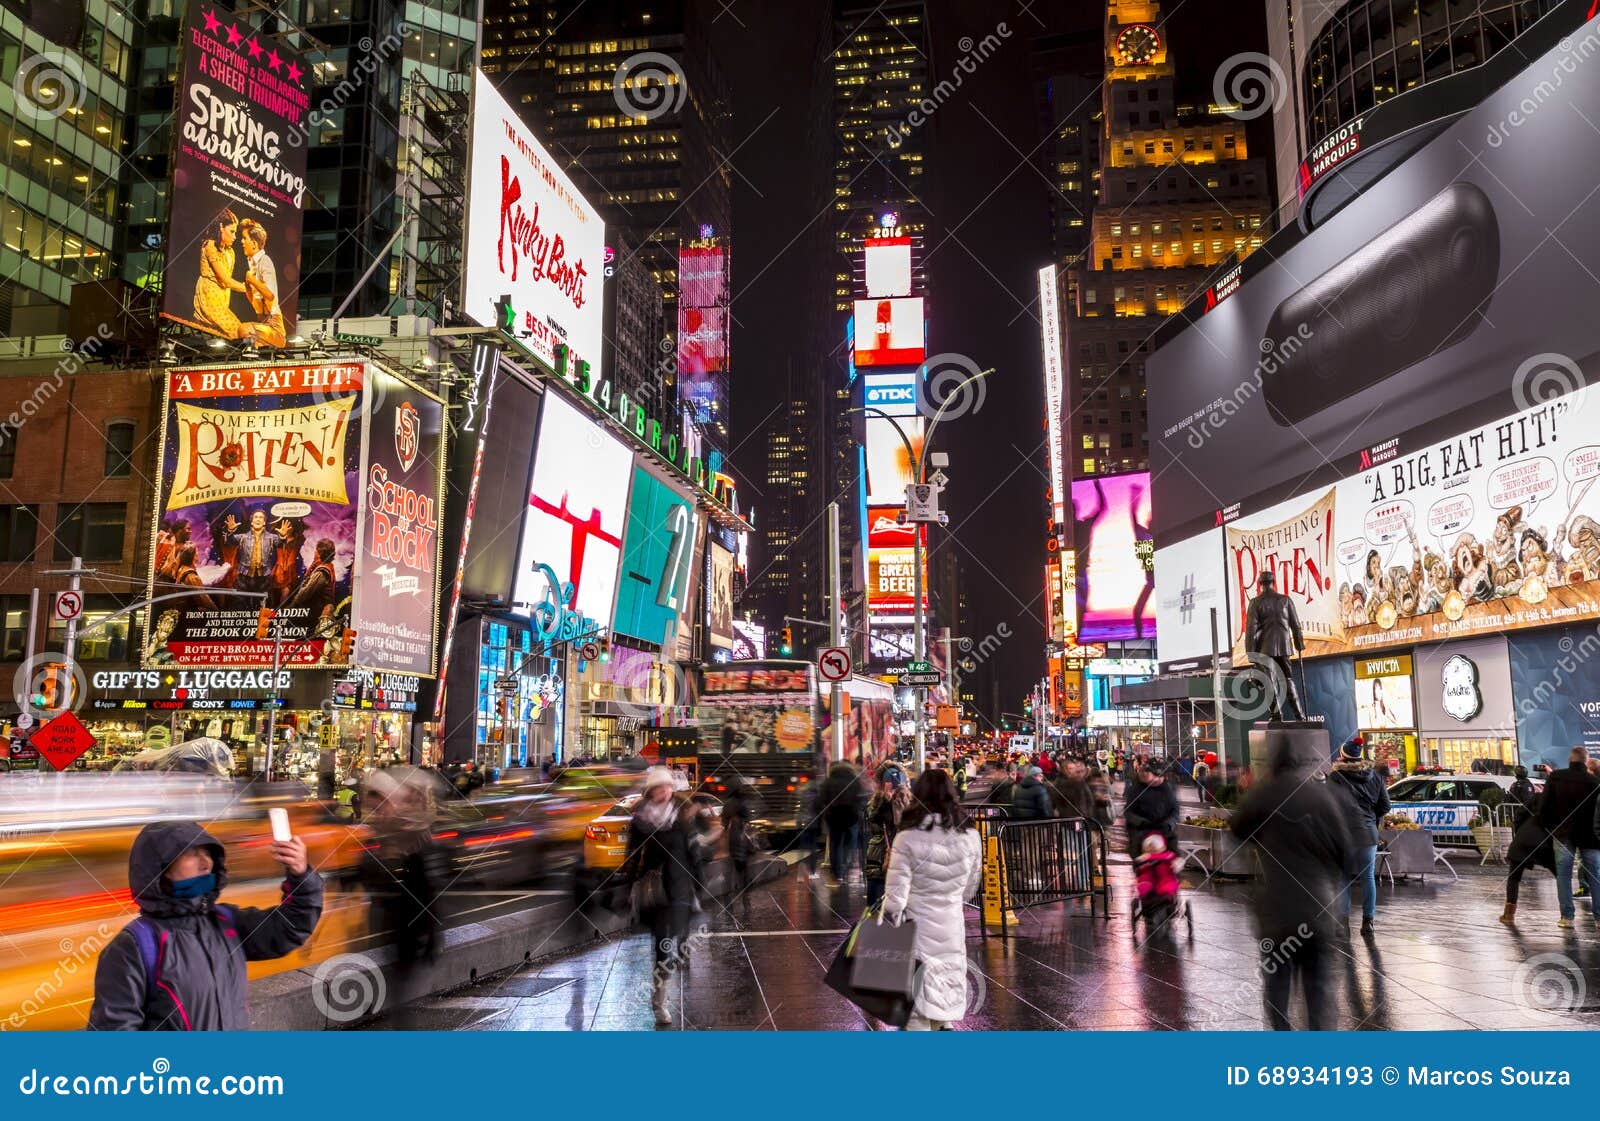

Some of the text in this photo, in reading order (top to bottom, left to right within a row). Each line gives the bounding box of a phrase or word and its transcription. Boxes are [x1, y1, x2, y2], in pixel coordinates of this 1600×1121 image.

[199, 52, 207, 74] A
[209, 57, 245, 95] SHEER
[190, 83, 282, 159] SPRING
[1312, 117, 1364, 161] MARRIOTT
[183, 121, 306, 209] awakening
[1313, 138, 1358, 177] MARQUIS
[874, 227, 902, 238] 2016
[546, 233, 587, 309] Boots
[1216, 265, 1242, 290] MARRIOTT
[525, 310, 549, 343] BEST
[340, 334, 378, 345] LAMAR
[252, 369, 295, 389] FAT
[883, 387, 912, 399] TDK
[201, 407, 327, 428] SOMETHING
[1372, 438, 1400, 454] MARRIOTT
[1440, 430, 1484, 479] FAT
[1241, 510, 1319, 551] SOMETHING
[371, 509, 432, 573] ROCK
[205, 619, 221, 627] AND
[223, 619, 235, 627] THE
[186, 628, 207, 637] THE
[210, 628, 241, 637] BOOK
[184, 645, 312, 654] ROTTENBROADWY.COM
[1366, 659, 1399, 675] INVICTA
[93, 671, 291, 689] GIFTS LUGGAGE
[380, 674, 419, 692] LUGGAGE
[123, 700, 147, 708] Nikon
[153, 700, 186, 709] Canon
[192, 700, 224, 708] SONY
[53, 725, 76, 733] ROAD
[321, 726, 329, 745] ATM
[1415, 810, 1456, 825] NYPD
